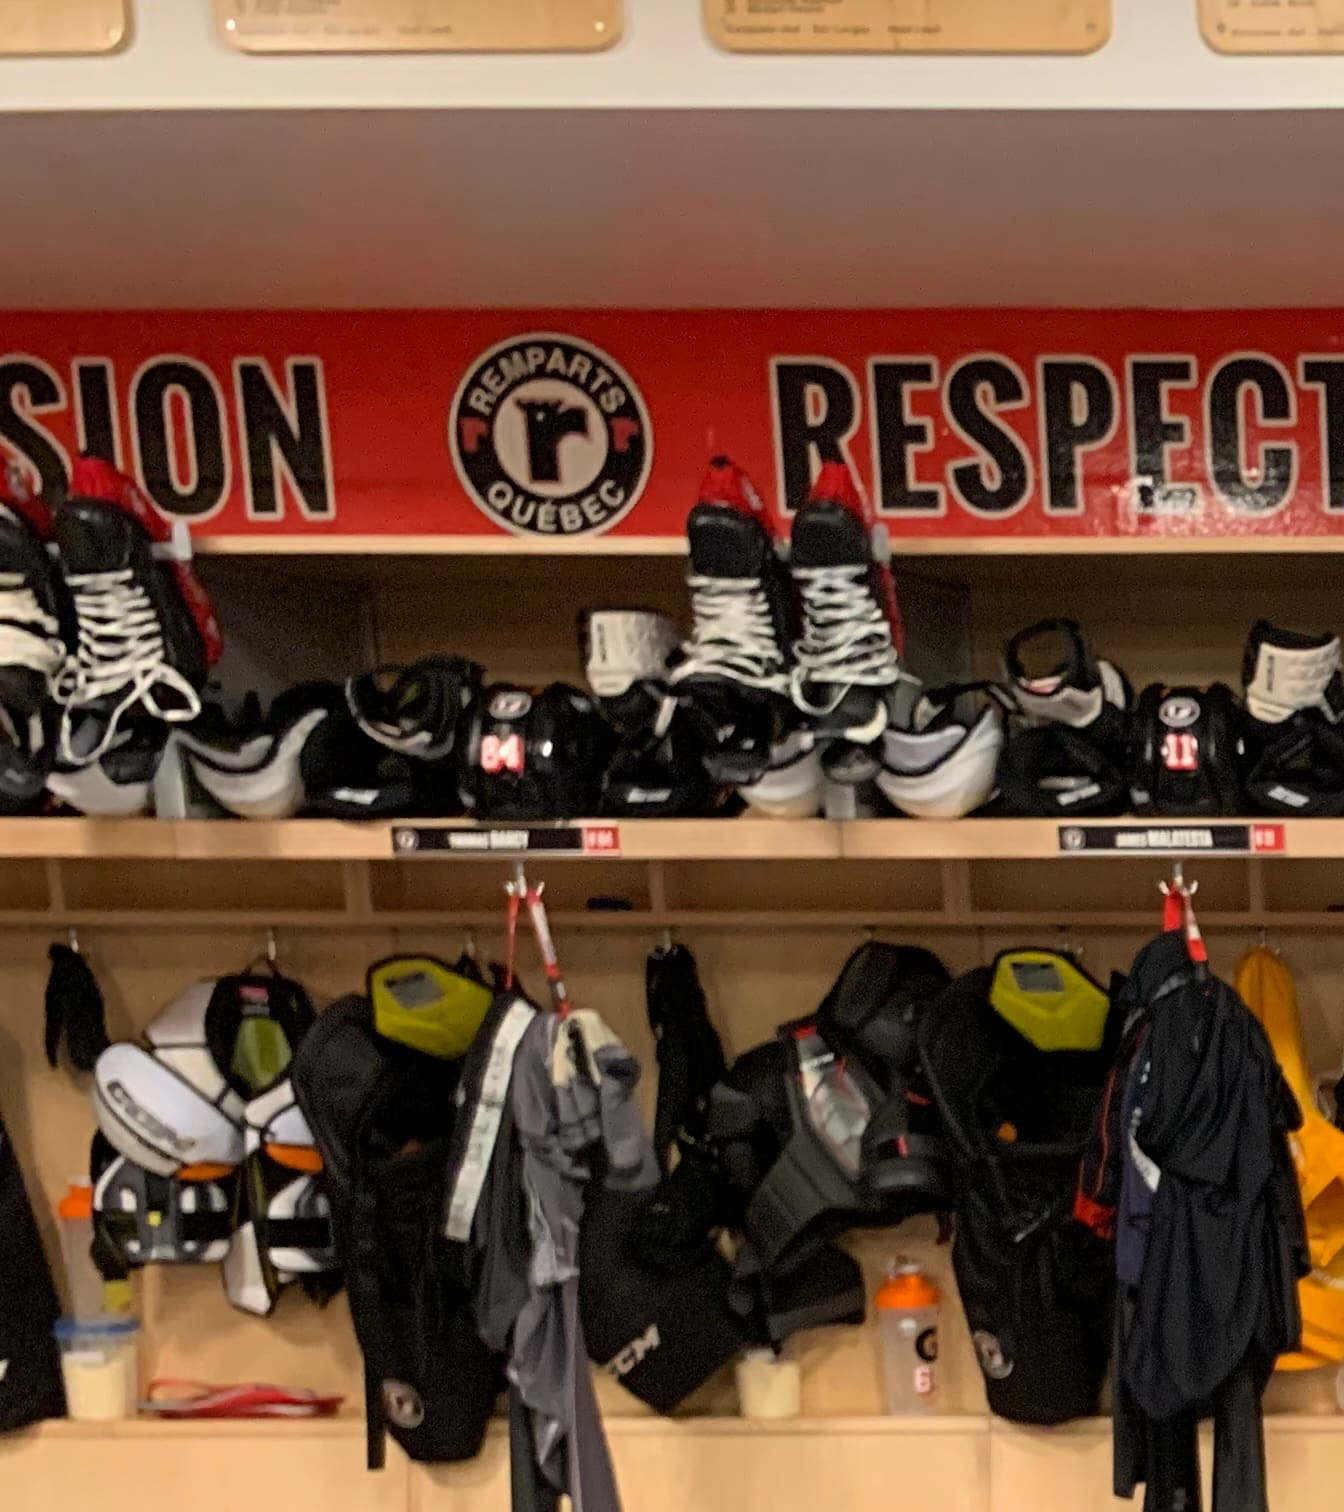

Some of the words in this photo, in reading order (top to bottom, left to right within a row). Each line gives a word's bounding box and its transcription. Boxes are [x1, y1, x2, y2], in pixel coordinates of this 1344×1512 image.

[469, 346, 626, 416] REMPARTS
[487, 479, 625, 532] QUÉBEC
[1163, 732, 1198, 770] 11
